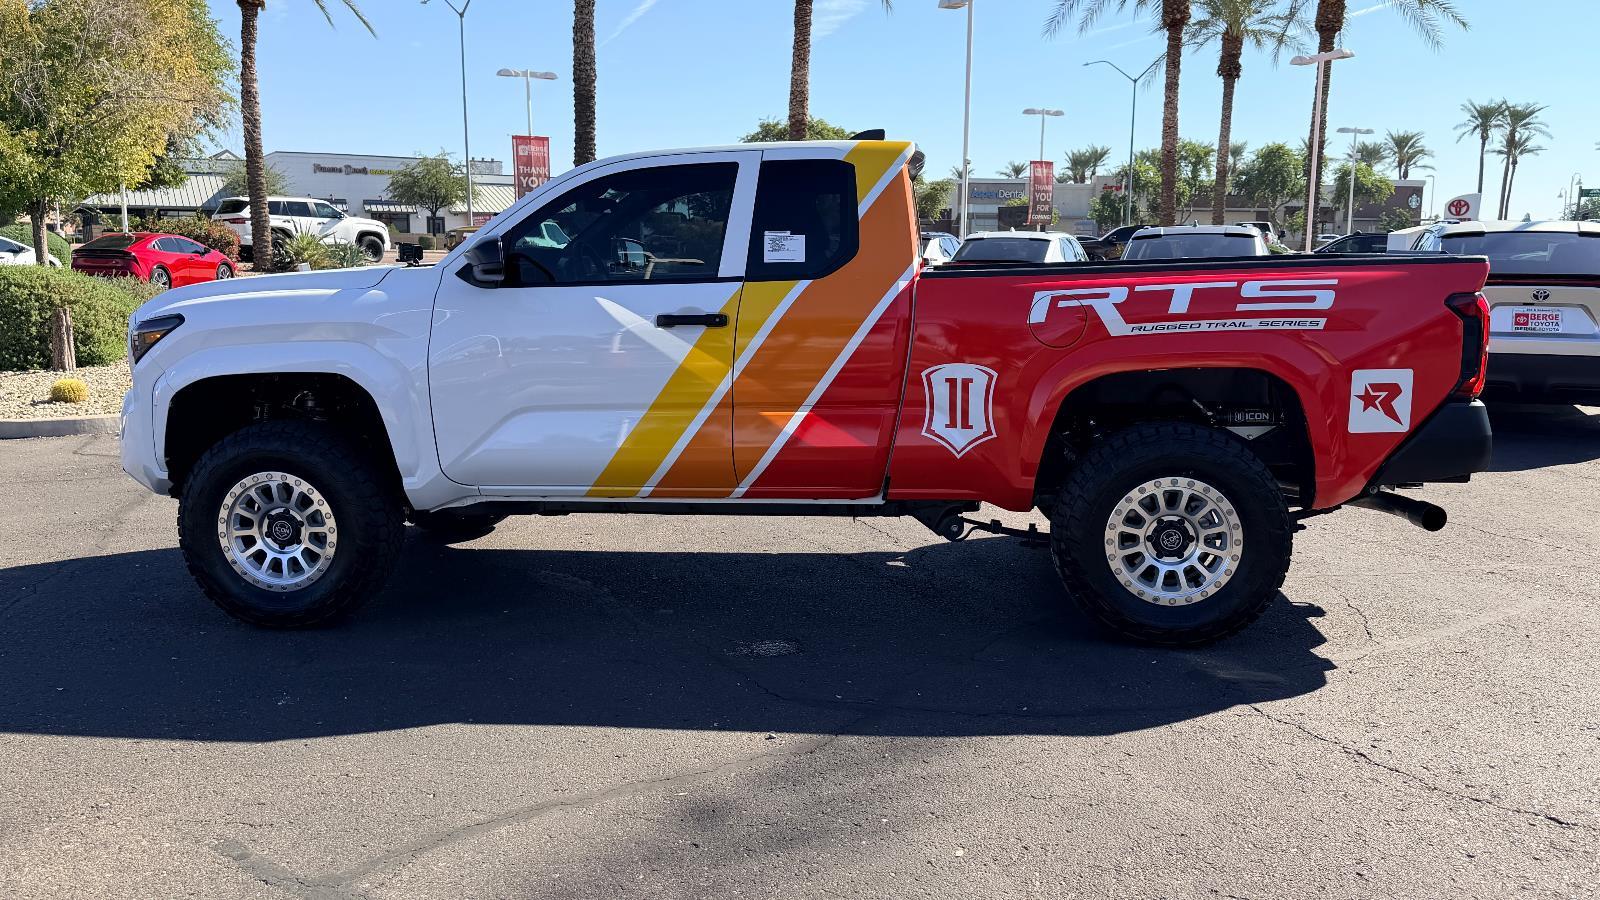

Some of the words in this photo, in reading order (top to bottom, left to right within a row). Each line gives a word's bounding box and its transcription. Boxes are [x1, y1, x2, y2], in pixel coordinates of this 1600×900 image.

[519, 166, 549, 175] THANK
[520, 176, 548, 188] YOU
[998, 189, 1025, 198] Dental
[1035, 193, 1052, 202] YOU
[1027, 279, 1339, 337] RTS
[1529, 313, 1560, 321] BERGE
[1131, 322, 1202, 333] RUGGED
[1206, 320, 1253, 329] TRAIL
[1258, 319, 1322, 328] SERIES
[1245, 412, 1270, 420] ICON
